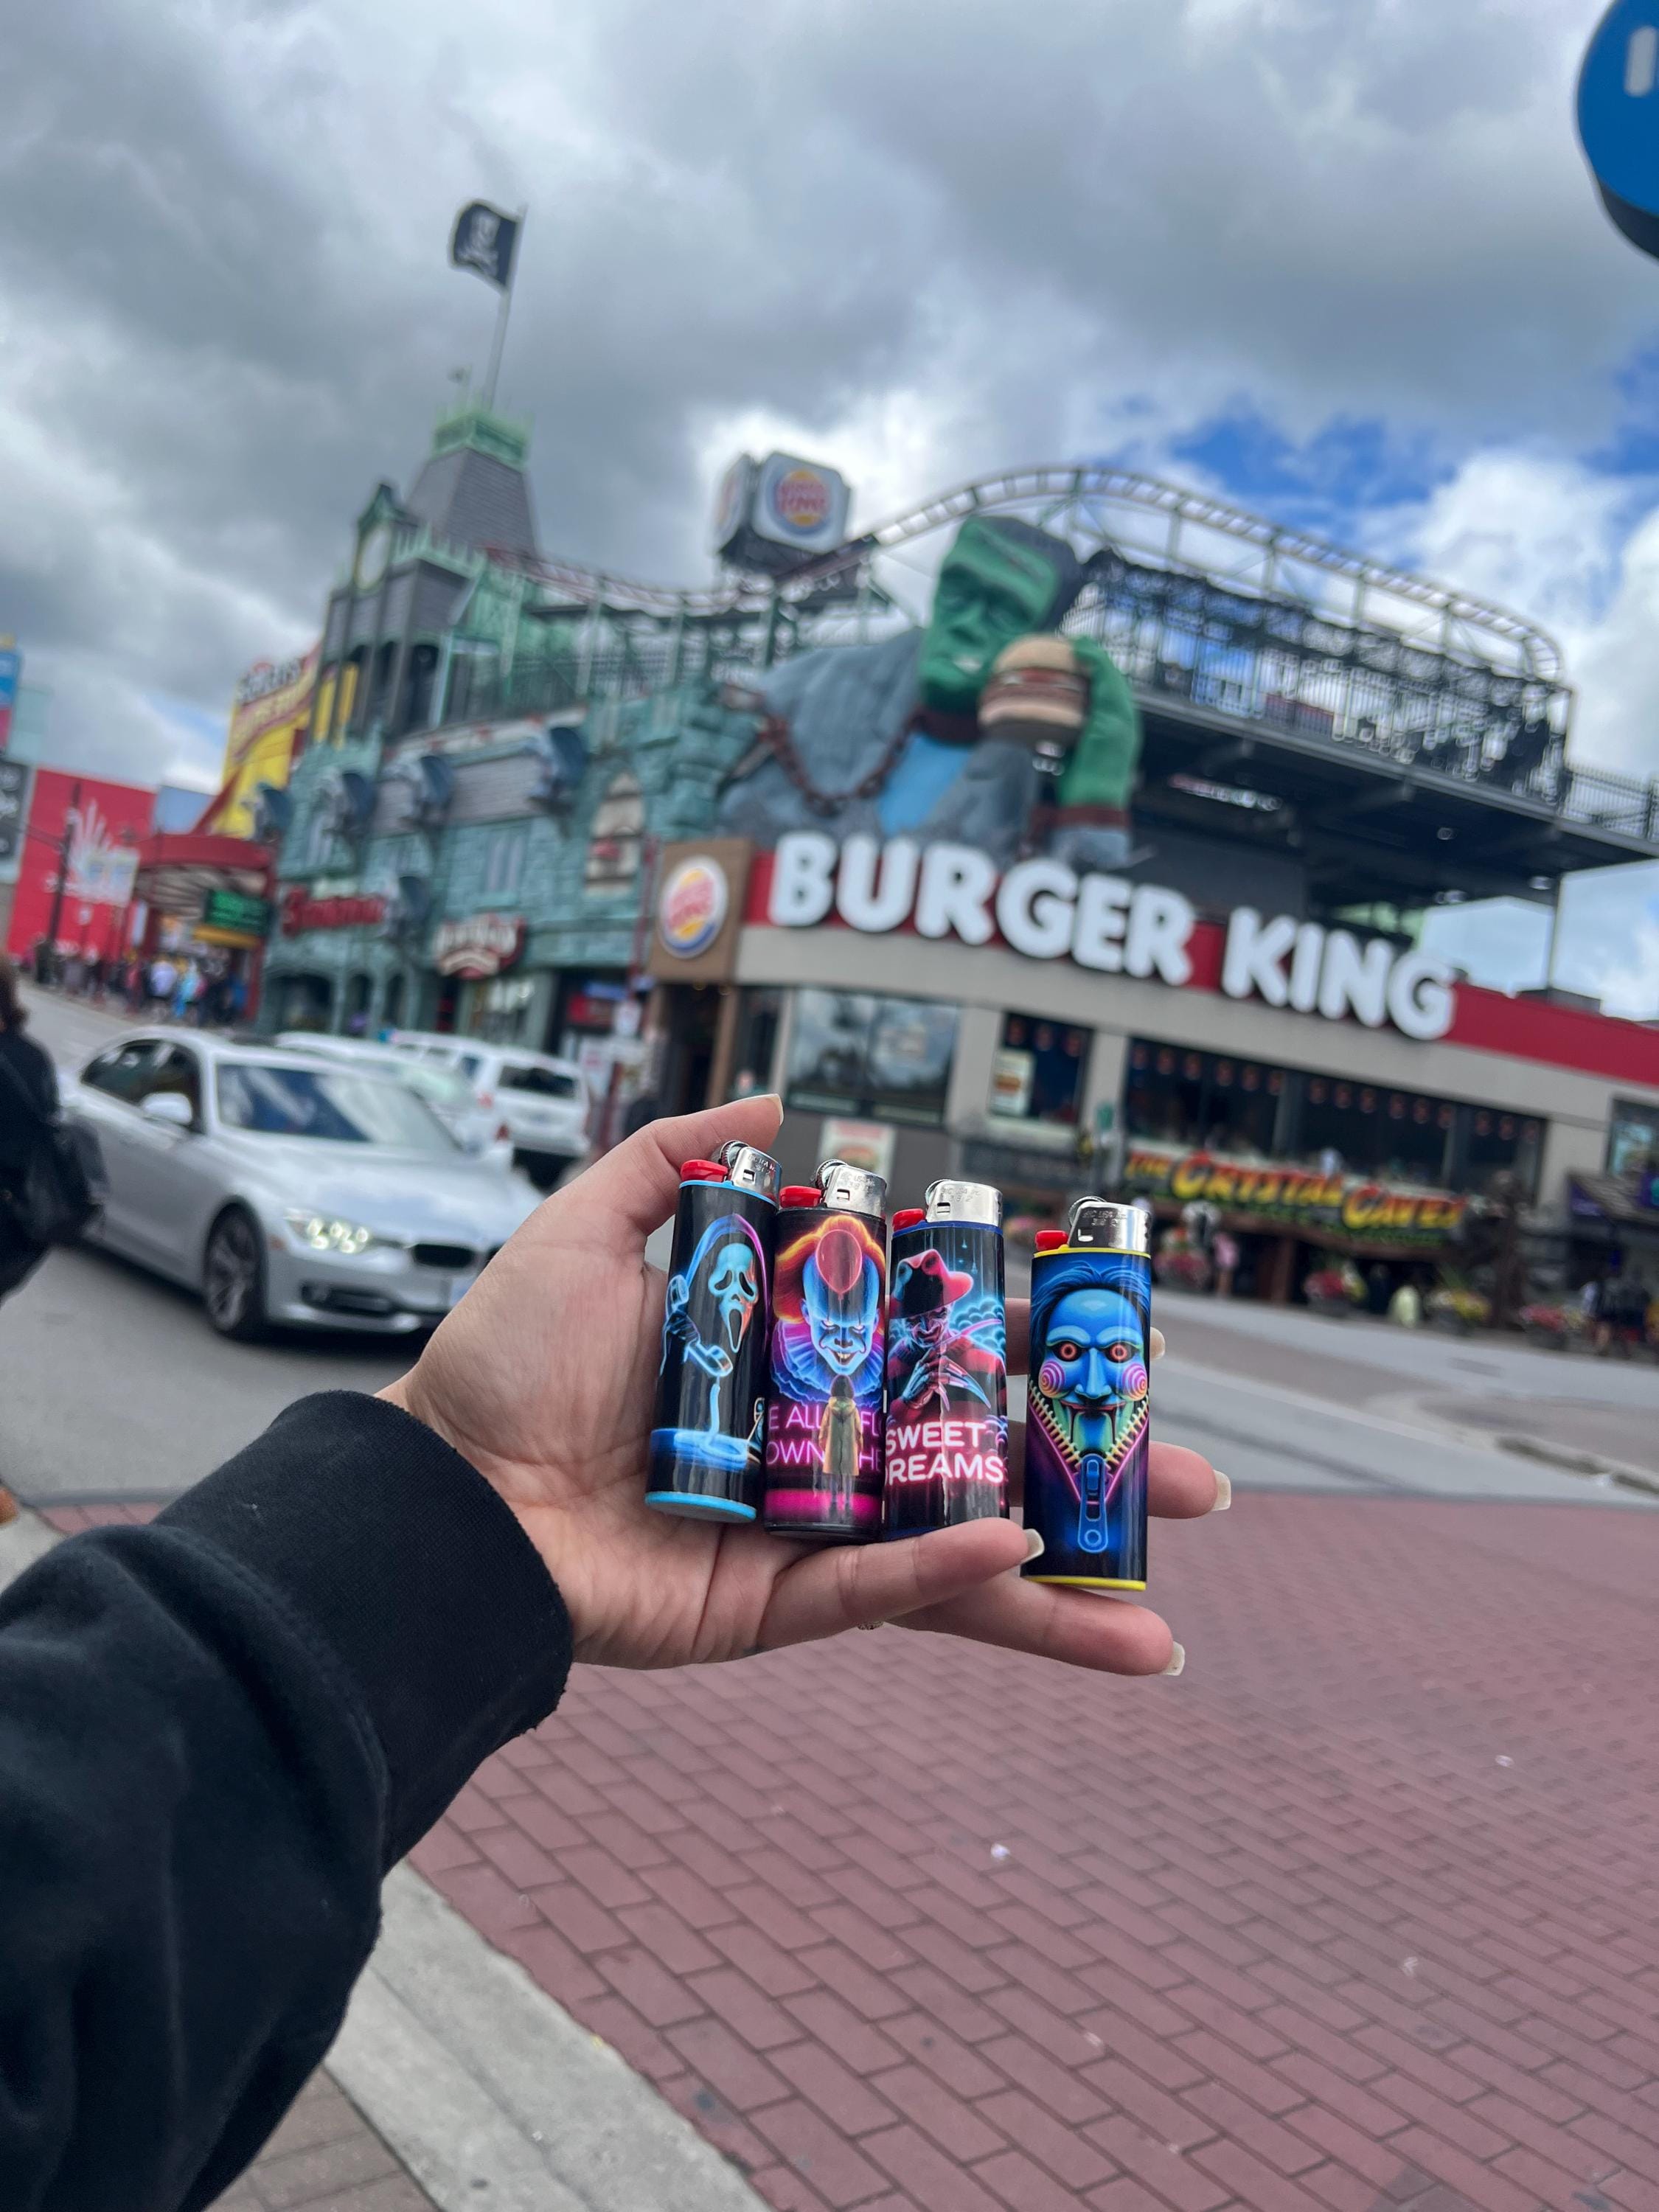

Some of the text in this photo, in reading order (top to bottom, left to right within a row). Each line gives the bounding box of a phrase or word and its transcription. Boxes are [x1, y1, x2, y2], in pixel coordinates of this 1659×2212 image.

[769, 831, 1457, 1041] BURGER KING
[785, 1402, 823, 1429] ALL
[860, 1411, 880, 1437] FL
[885, 1420, 987, 1457] SWEET
[884, 1452, 1004, 1486] REAMS
